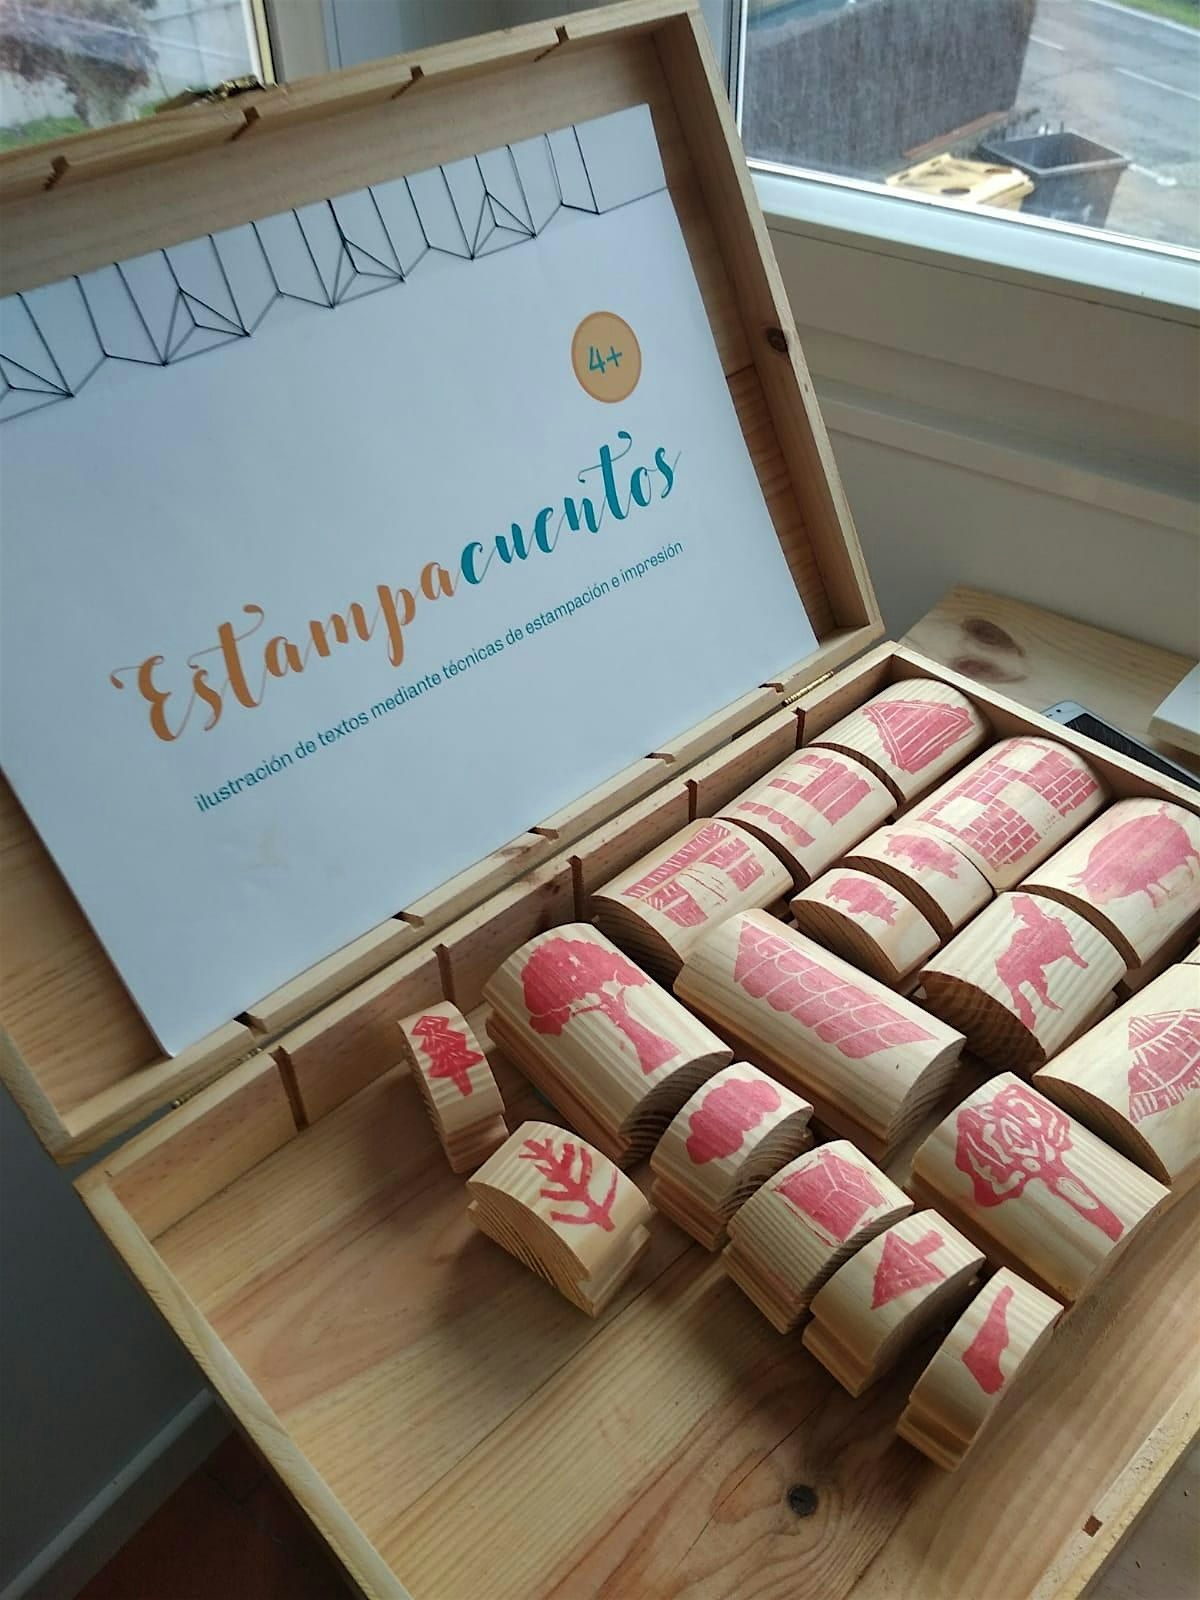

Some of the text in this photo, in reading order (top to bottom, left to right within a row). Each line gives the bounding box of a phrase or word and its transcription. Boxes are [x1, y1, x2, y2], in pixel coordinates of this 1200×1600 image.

[588, 345, 623, 374] 4+
[110, 431, 681, 742] Estampacuentos
[194, 541, 684, 812] ilustración de textos mediante técnicas de estampación e impresión
